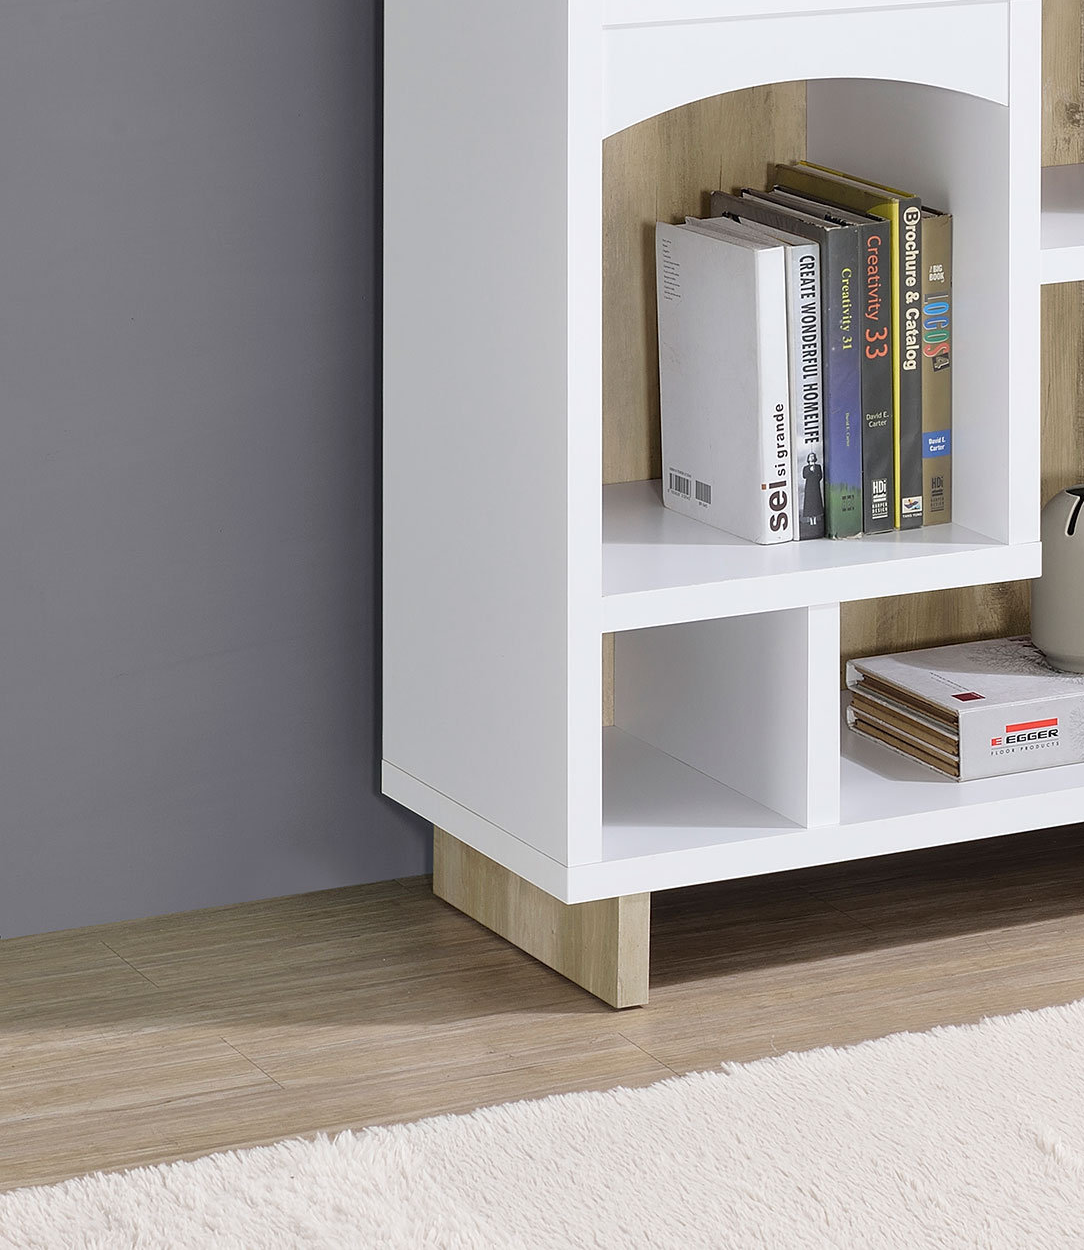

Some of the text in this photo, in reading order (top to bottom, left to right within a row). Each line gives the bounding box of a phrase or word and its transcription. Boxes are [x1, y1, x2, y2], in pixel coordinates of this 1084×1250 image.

[840, 267, 853, 350] Creativity 31
[865, 235, 888, 359] Creativity 33
[903, 206, 921, 371] Brochure & Catalog
[799, 255, 819, 444] CREATE WONDERFUL HOMELIFE
[923, 294, 950, 358] LOGOS
[866, 412, 882, 421] David
[868, 419, 887, 428] Carter
[761, 403, 789, 532] sei si grande
[990, 741, 1060, 756] FLOOR PRODUCTS
[1005, 728, 1059, 744] EGGER
